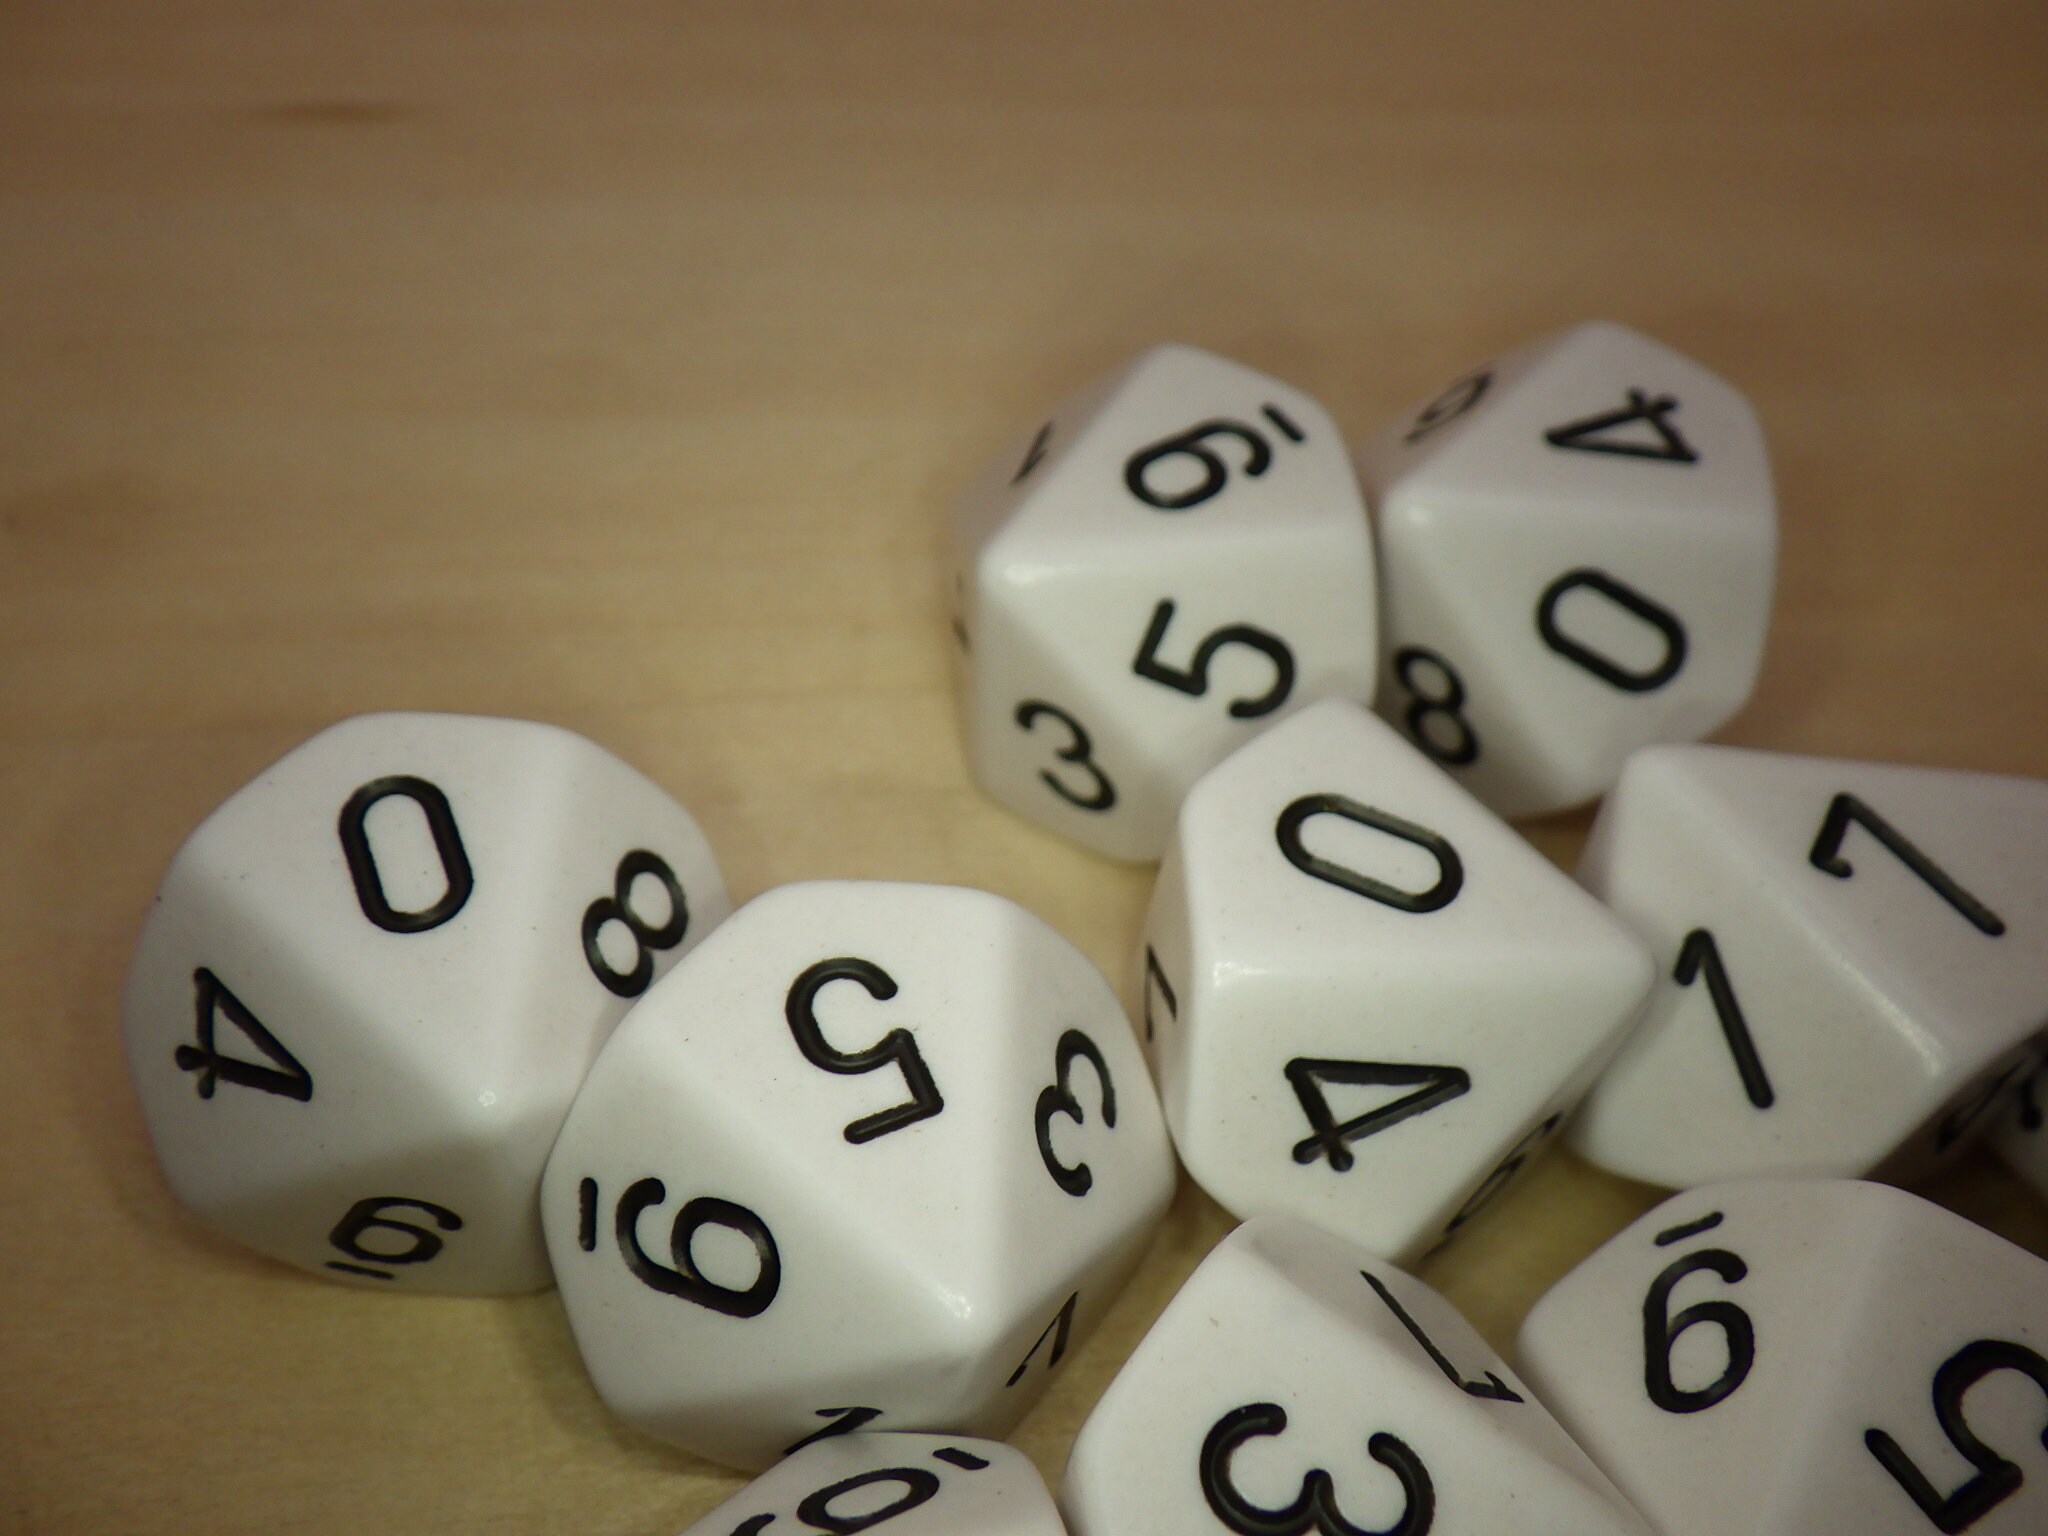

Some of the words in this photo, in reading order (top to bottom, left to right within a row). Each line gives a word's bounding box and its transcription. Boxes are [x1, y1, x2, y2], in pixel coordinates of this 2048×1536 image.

[1545, 390, 1700, 465] 4
[1132, 598, 1297, 722] 5
[1535, 567, 1689, 695] 0
[1014, 700, 1118, 813] 3
[1394, 645, 1481, 768] 8
[338, 775, 475, 935] 0
[1275, 793, 1465, 915] 0
[1808, 793, 2007, 938] 7
[580, 848, 690, 1000] 8
[175, 967, 314, 1103] 4
[785, 956, 945, 1145] 5
[1671, 927, 1776, 1111] 1
[1034, 1028, 1117, 1198] 3
[1284, 1056, 1472, 1173] 4
[324, 1196, 464, 1281] 6
[1198, 1401, 1437, 1536] 3
[1863, 1337, 2048, 1536] 5
